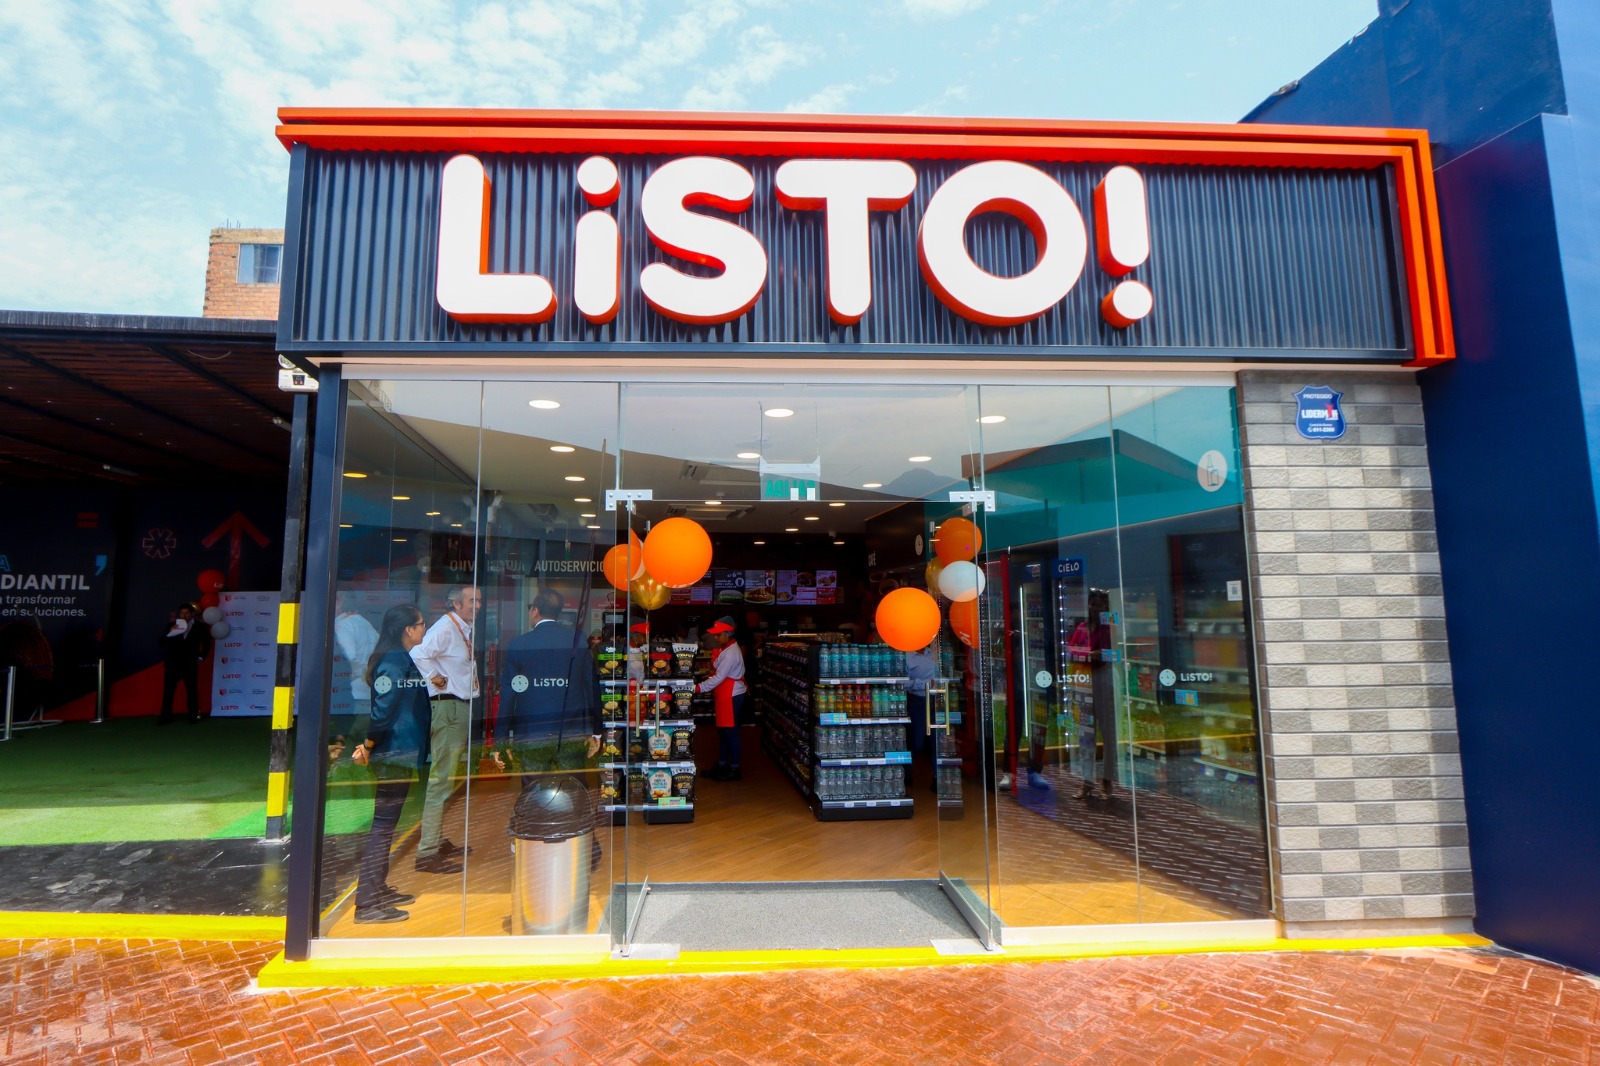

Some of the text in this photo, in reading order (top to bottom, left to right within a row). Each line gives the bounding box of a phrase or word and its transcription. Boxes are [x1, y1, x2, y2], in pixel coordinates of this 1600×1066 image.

[436, 154, 1154, 325] LiSTO!
[1057, 562, 1080, 573] CIELO
[1, 573, 90, 591] DIANTIL
[6, 594, 76, 605] transformar
[2, 608, 17, 617] en
